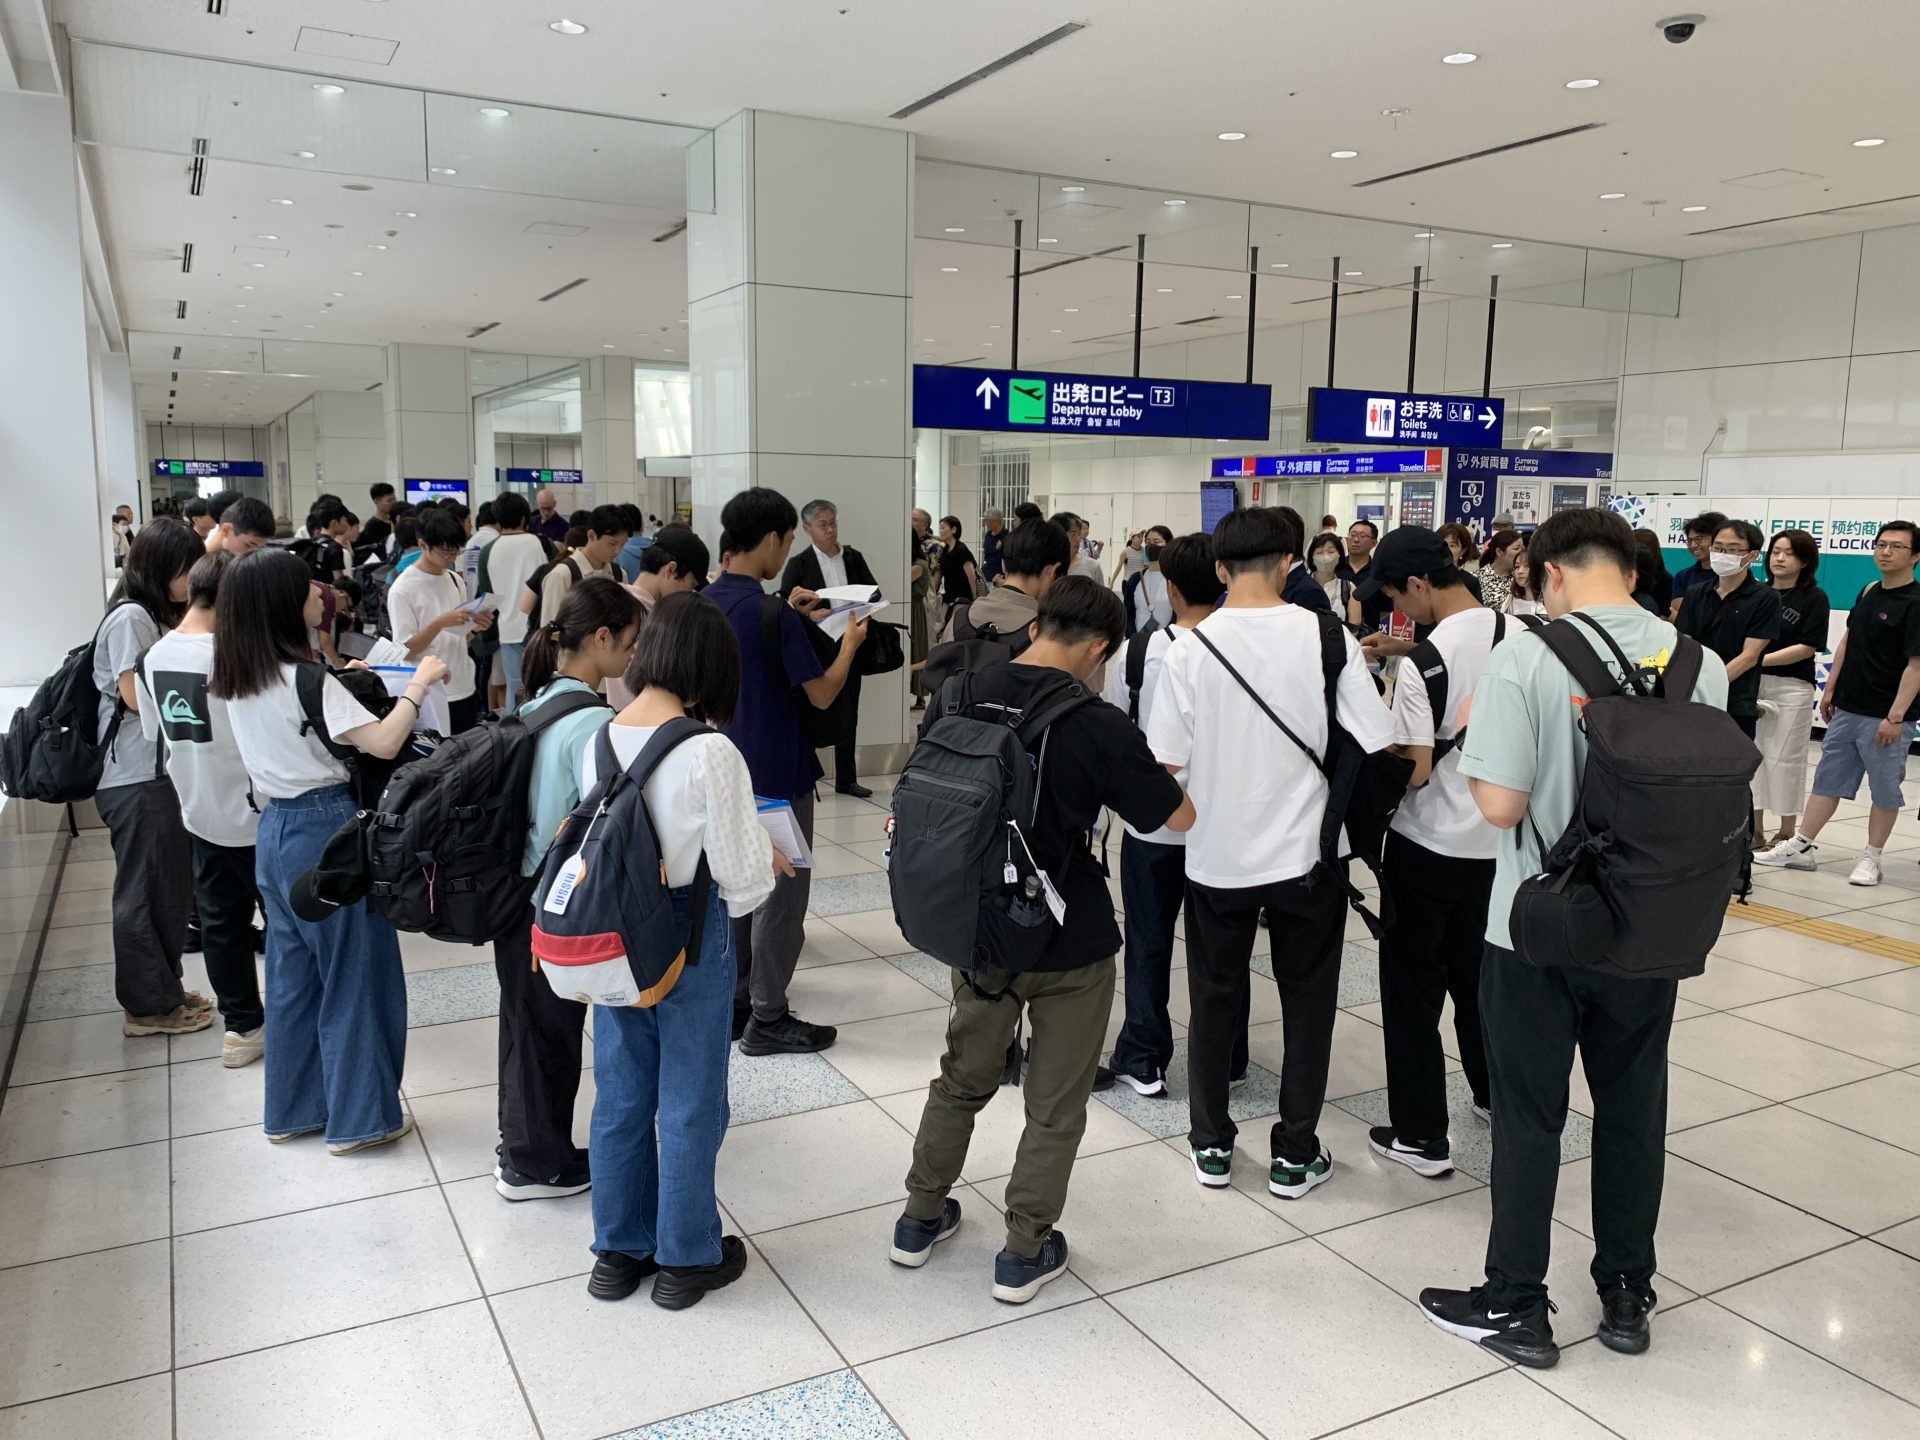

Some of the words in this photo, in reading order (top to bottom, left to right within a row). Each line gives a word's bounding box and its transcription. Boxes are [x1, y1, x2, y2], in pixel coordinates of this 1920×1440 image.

[1052, 382, 1143, 404] 出発ロビー
[1154, 389, 1171, 404] T3
[1052, 402, 1107, 417] Departure
[1110, 405, 1142, 420] Lobby
[1400, 400, 1442, 419] お手洗
[1400, 418, 1428, 429] Toilets
[1326, 458, 1350, 466] Currency
[1470, 455, 1510, 470] 外貨両替
[1515, 456, 1538, 465] Currency
[1287, 460, 1322, 474] 外貨両替
[1326, 465, 1350, 474] Exchange
[1399, 463, 1424, 472] Travelex
[1515, 464, 1538, 472] Exchange
[1512, 491, 1531, 500] 友だち
[1831, 520, 1884, 536] 预约商
